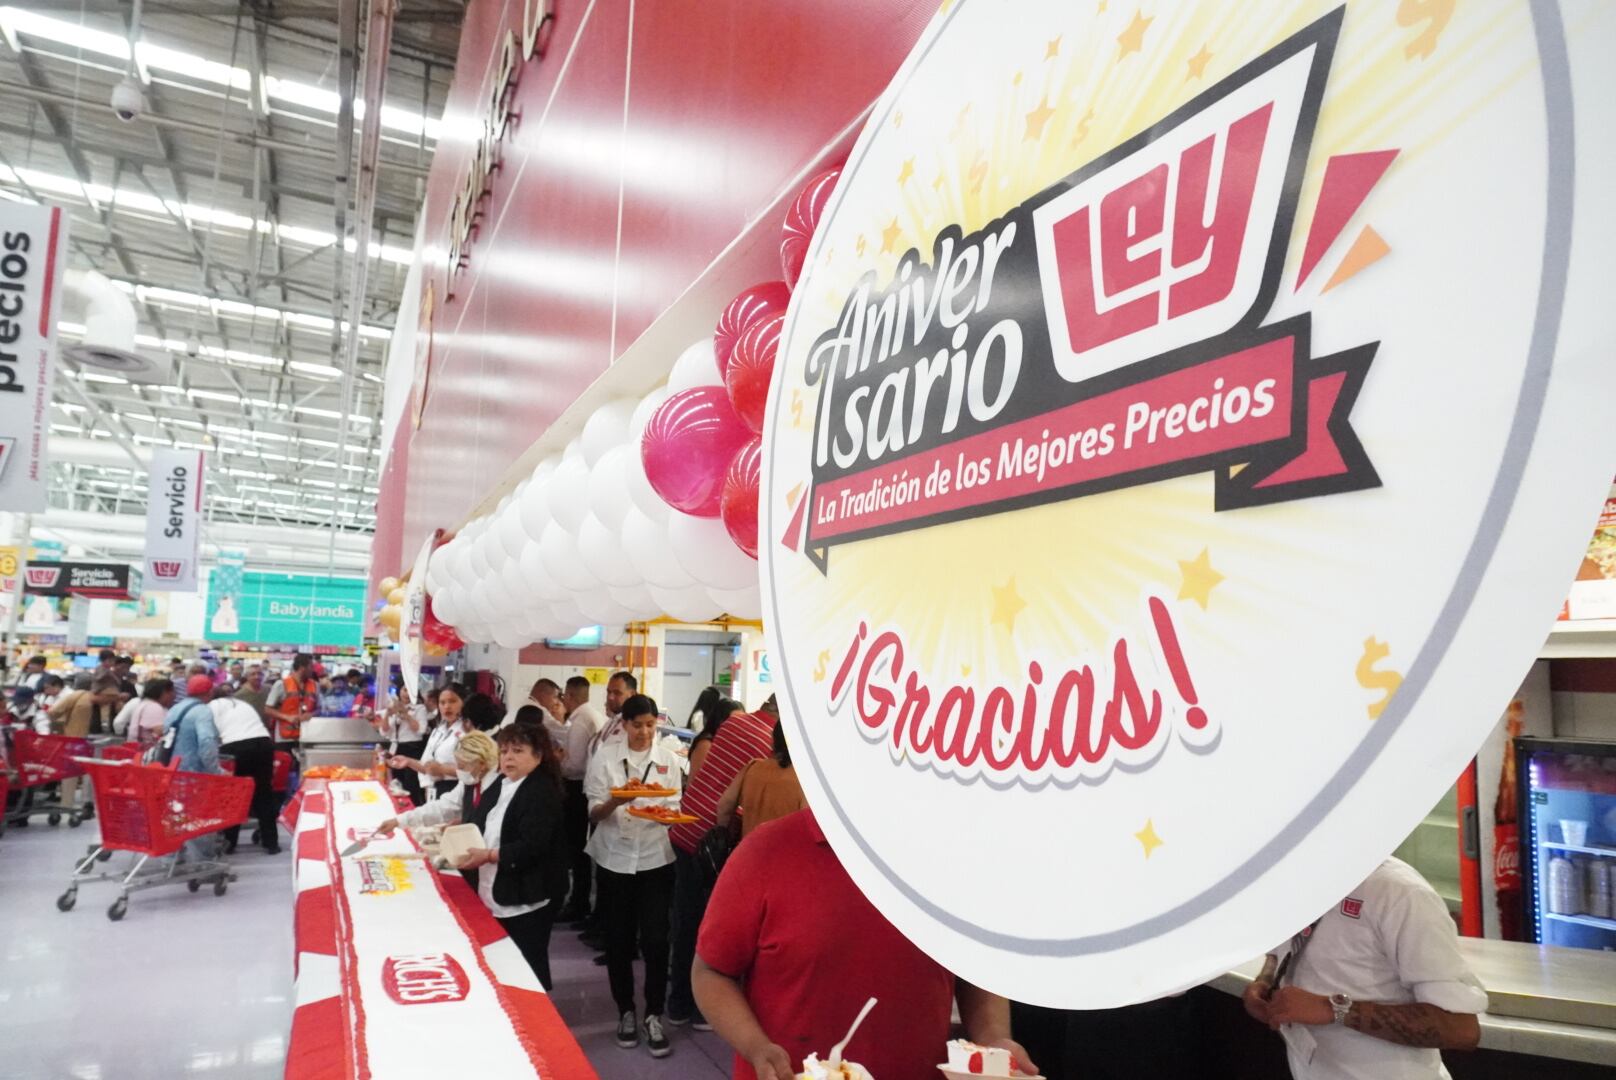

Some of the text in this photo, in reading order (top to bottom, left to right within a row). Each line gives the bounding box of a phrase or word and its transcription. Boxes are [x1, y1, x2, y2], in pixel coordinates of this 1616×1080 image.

[809, 221, 1017, 467] Aniver
[832, 318, 1023, 469] sario
[164, 466, 187, 539] Servicio
[817, 377, 1276, 525] La Tradición de los Mejores Precios
[70, 567, 115, 579] Servicio
[70, 578, 119, 588] al Cliente
[269, 601, 354, 620] Babylandia
[830, 595, 1209, 772] ¡Gracias!
